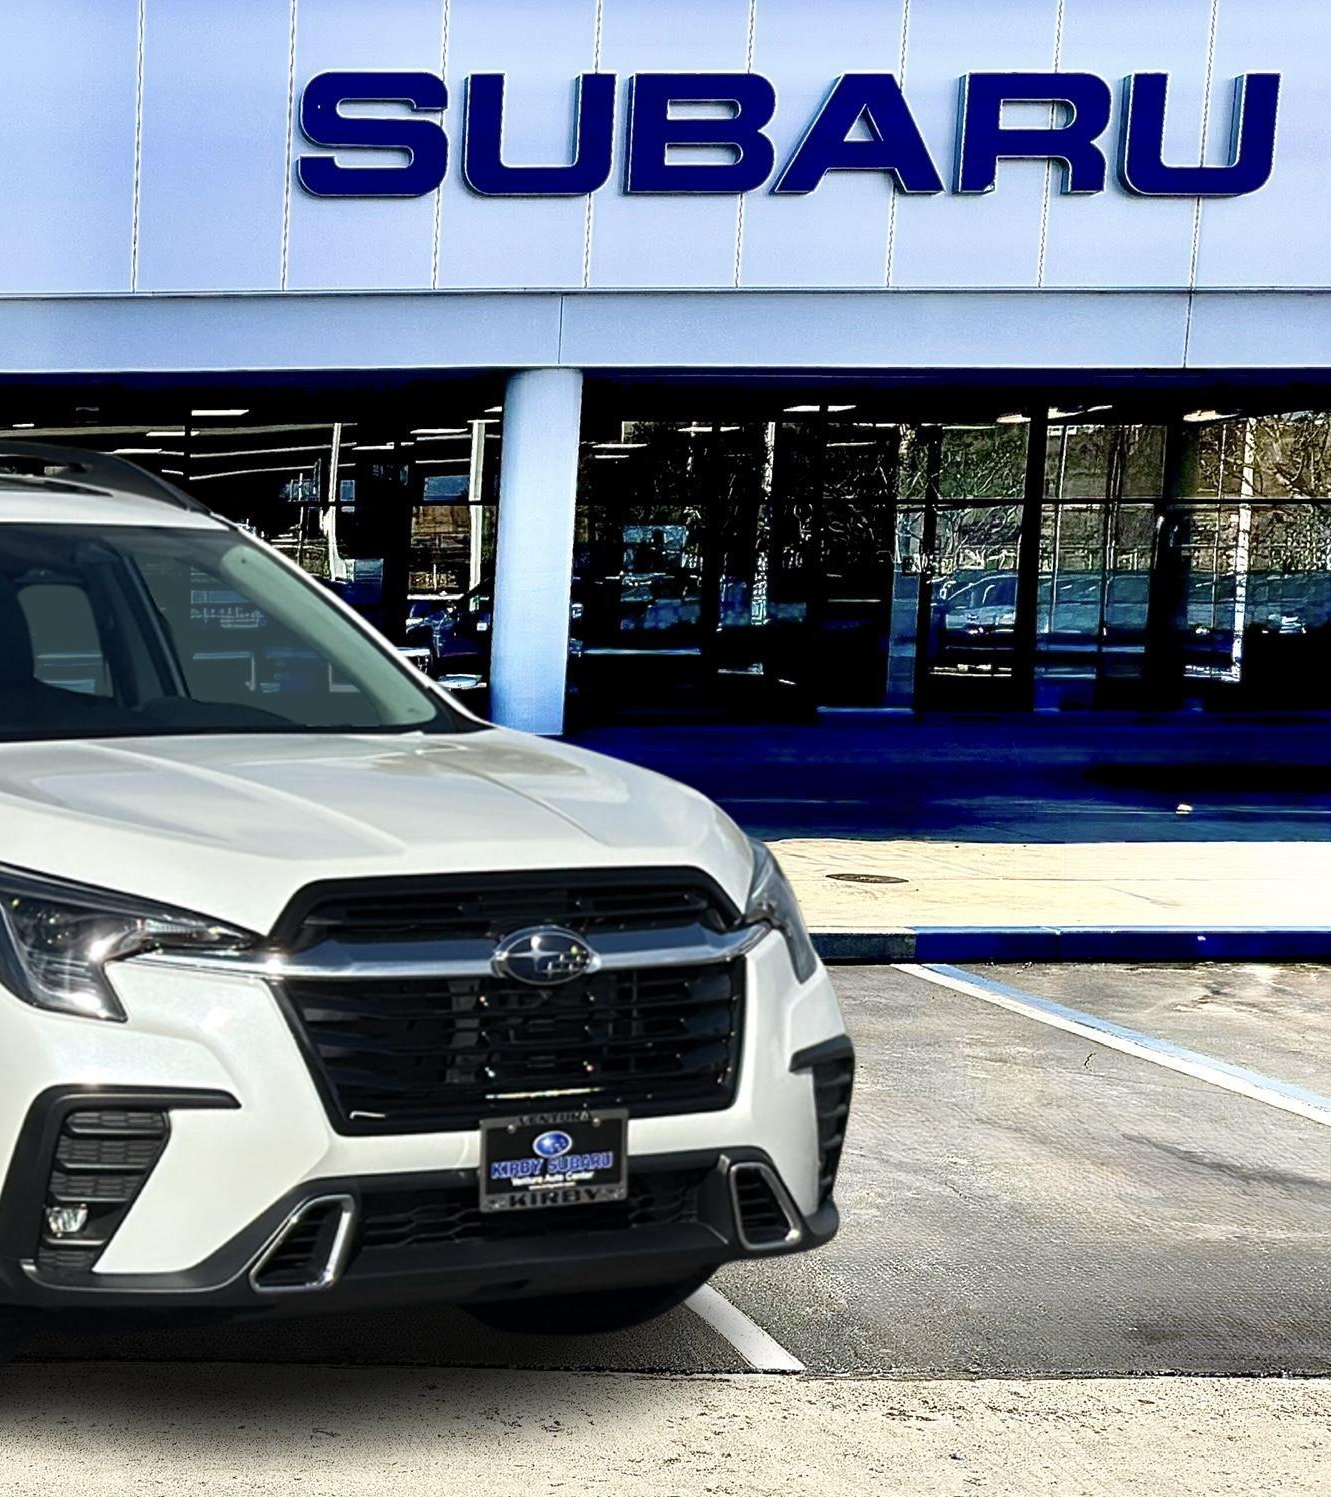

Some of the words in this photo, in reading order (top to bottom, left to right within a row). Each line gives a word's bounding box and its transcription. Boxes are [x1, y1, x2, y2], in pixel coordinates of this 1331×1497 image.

[297, 71, 1281, 197] SUBARU
[491, 1159, 543, 1179] KIRBY
[548, 1152, 613, 1174] SUBARU
[509, 1189, 599, 1206] KIRBY
